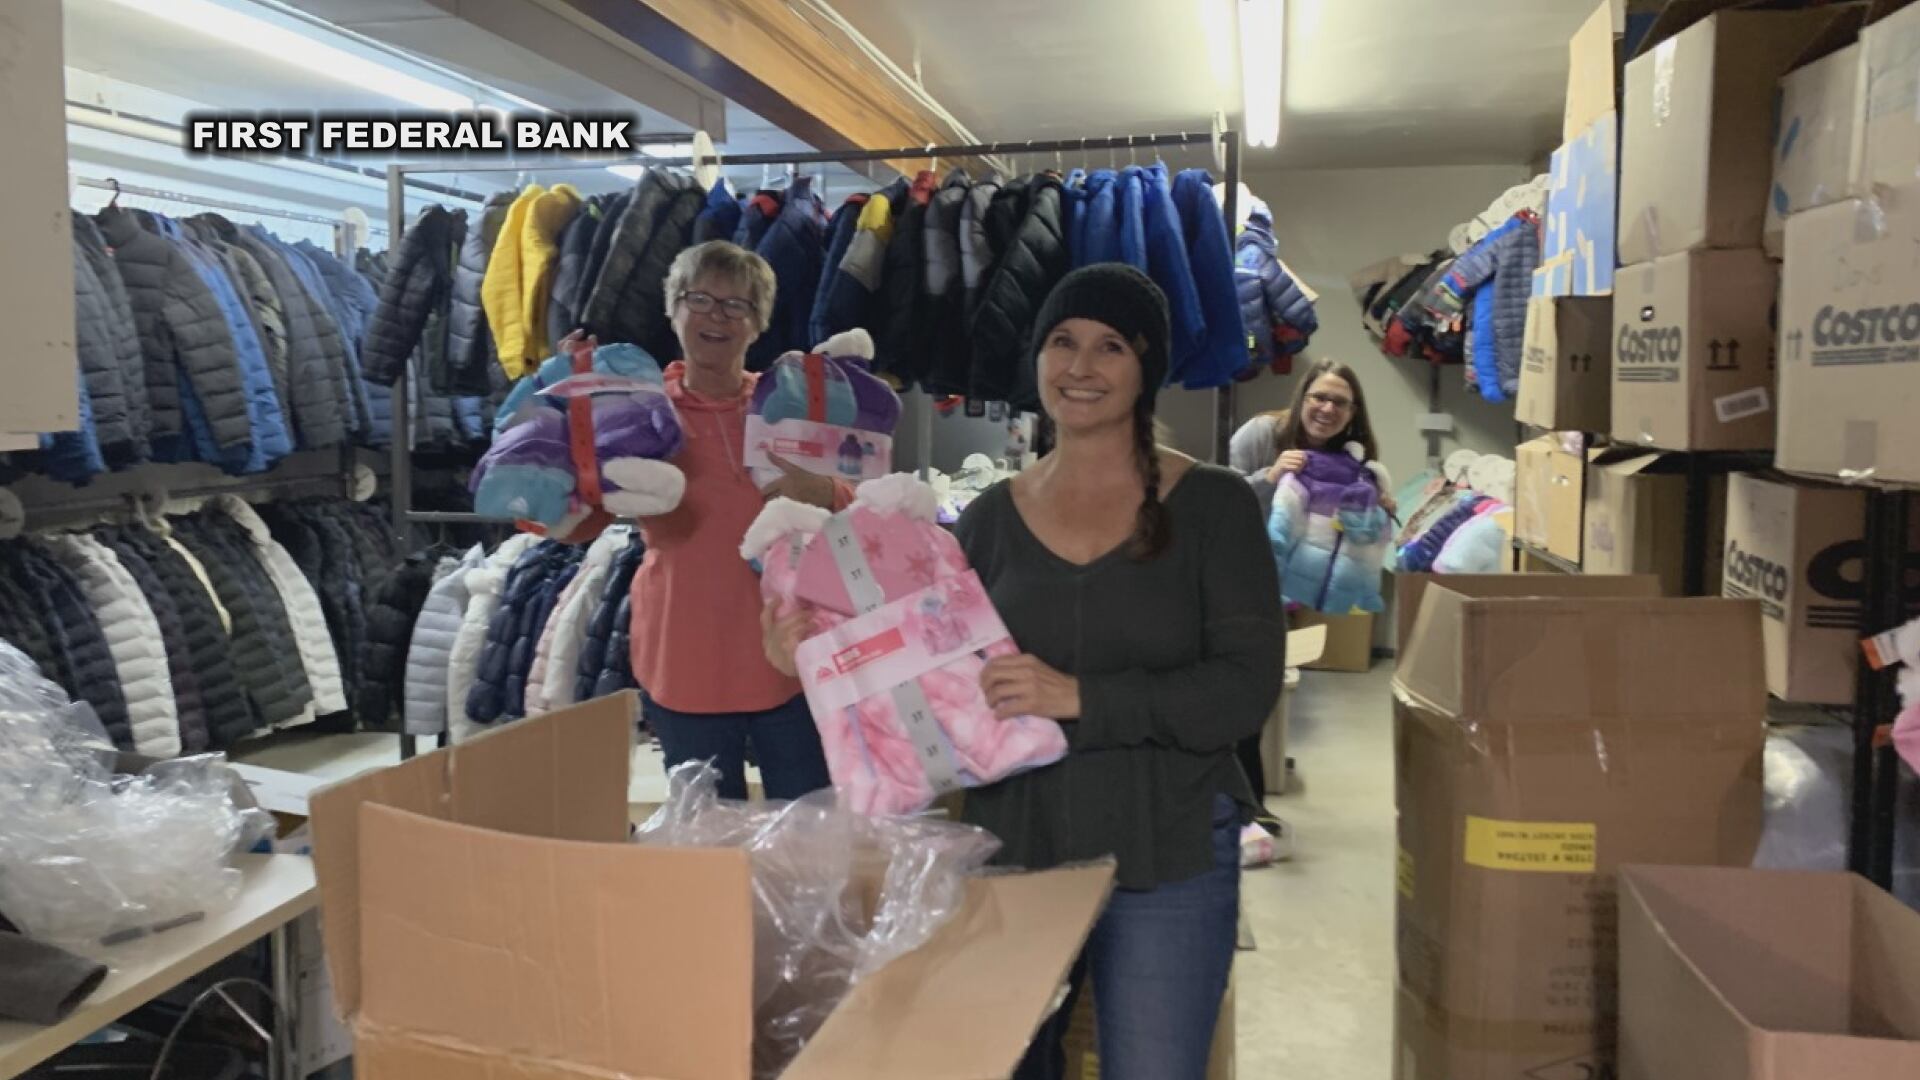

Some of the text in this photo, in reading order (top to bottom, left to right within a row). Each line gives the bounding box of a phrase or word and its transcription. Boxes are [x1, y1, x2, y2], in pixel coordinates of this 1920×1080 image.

[1617, 322, 1682, 363] COSTCO
[1813, 303, 1920, 347] COSTCO
[1727, 539, 1788, 601] COSTCO
